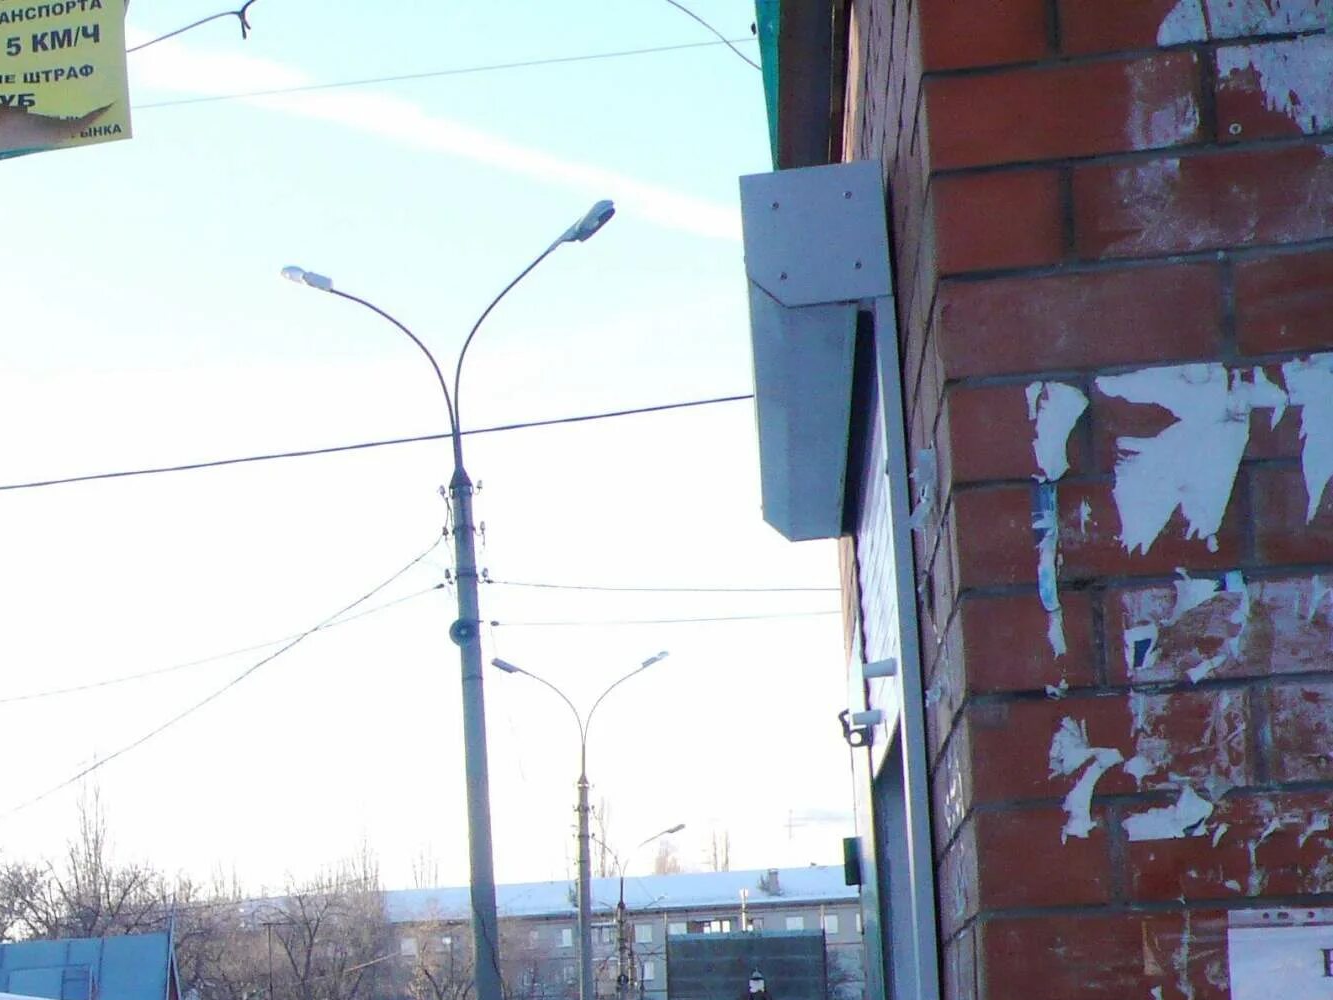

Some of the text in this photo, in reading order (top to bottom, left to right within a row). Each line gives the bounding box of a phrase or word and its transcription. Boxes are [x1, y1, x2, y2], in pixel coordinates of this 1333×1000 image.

[6, 36, 22, 57] 5
[31, 23, 100, 53] КМ/Ч
[22, 64, 95, 84] ШТРАФ
[71, 123, 122, 139] ЫНКА
